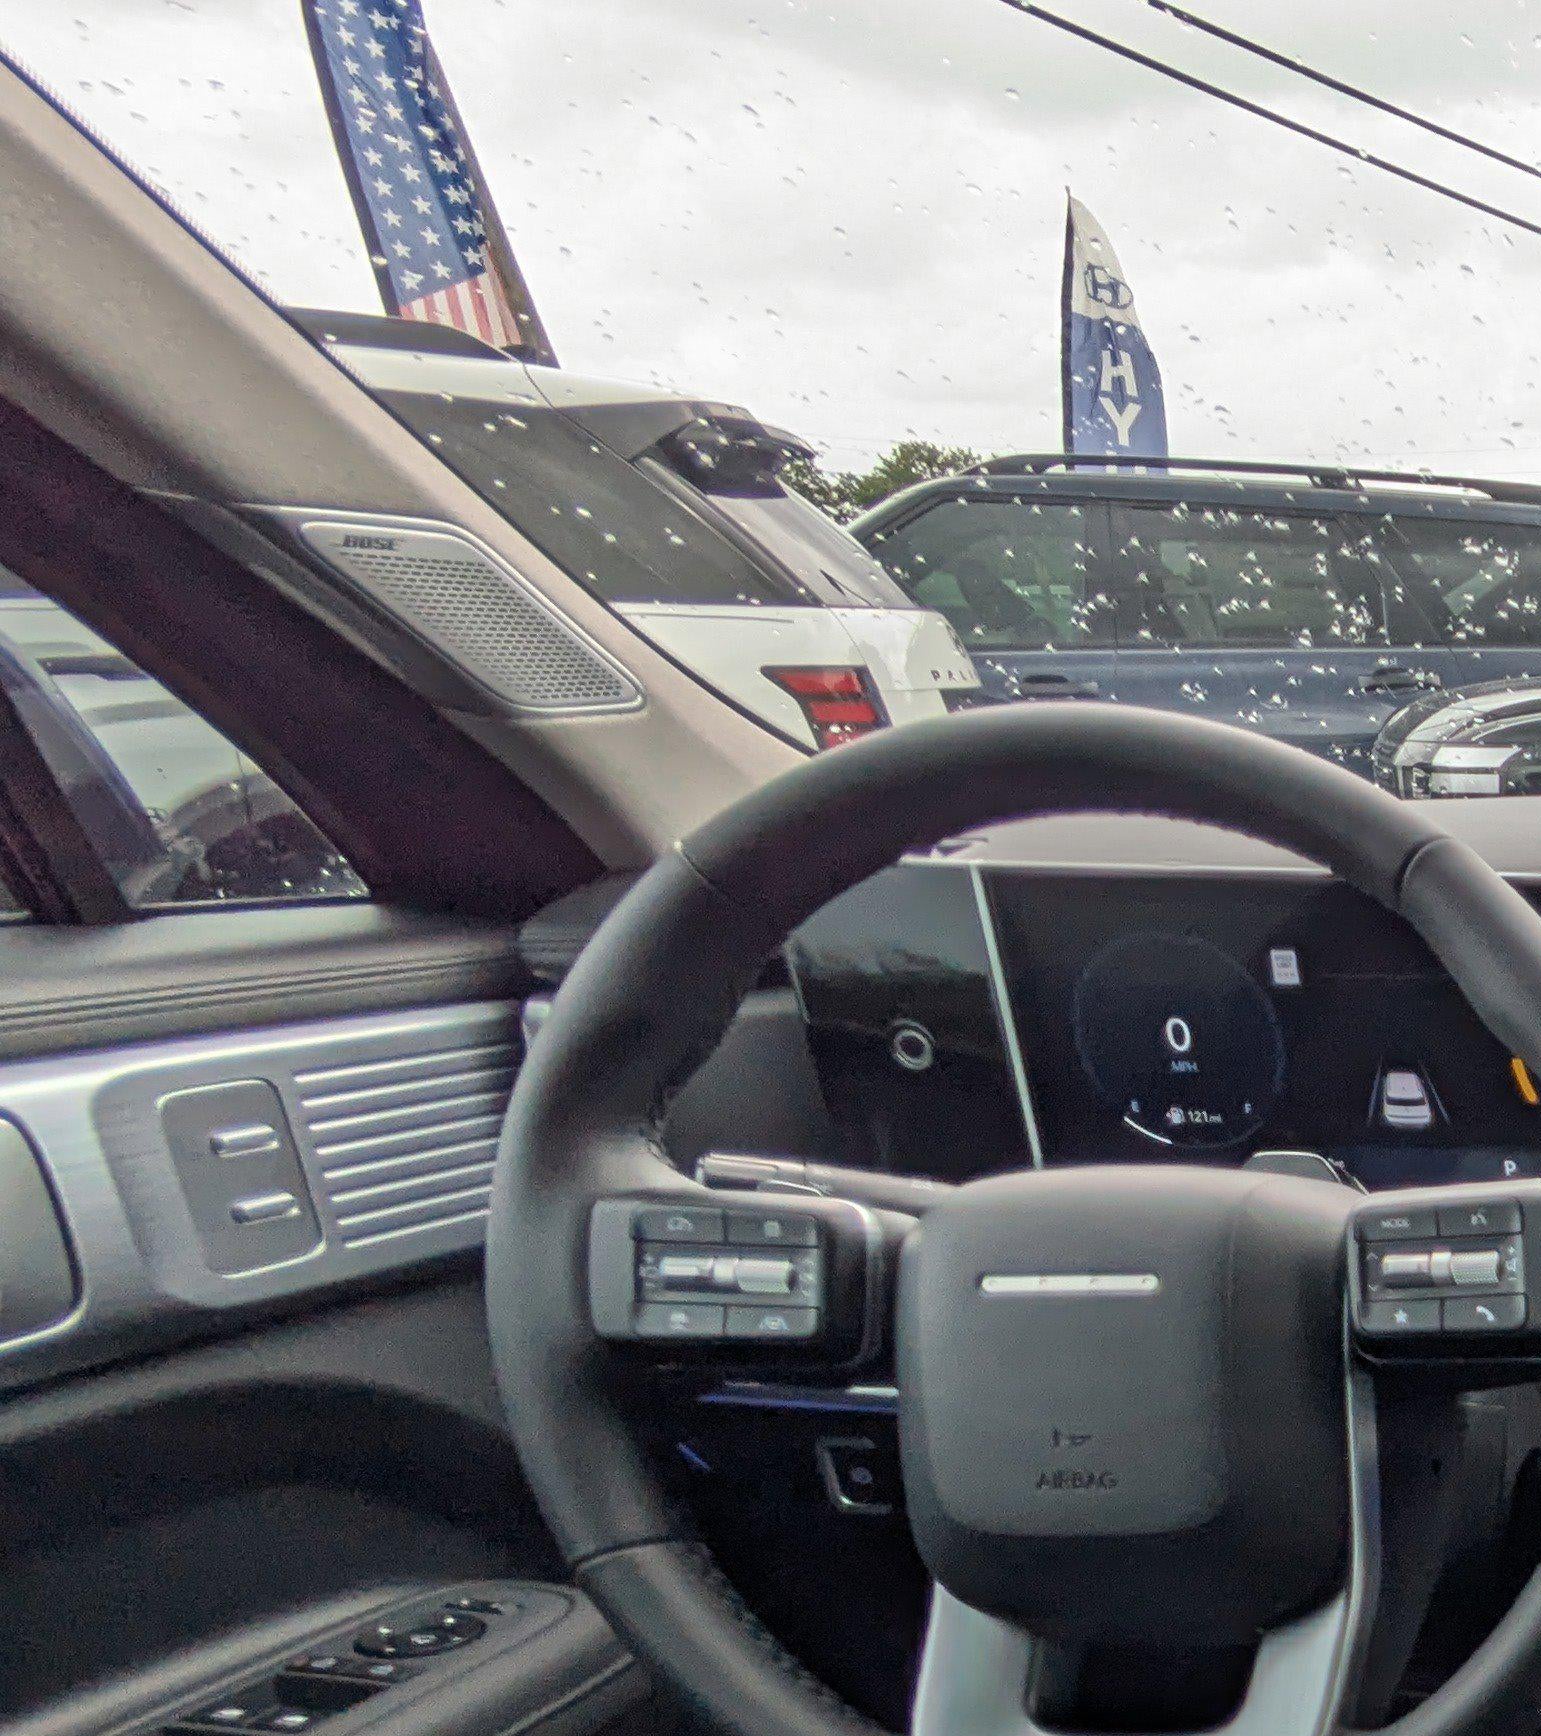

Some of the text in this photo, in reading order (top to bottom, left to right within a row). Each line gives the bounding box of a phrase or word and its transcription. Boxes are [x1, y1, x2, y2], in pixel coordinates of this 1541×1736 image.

[1165, 1017, 1191, 1051] 0
[1171, 1060, 1198, 1072] MPH
[1504, 1159, 1518, 1176] P
[1036, 1469, 1118, 1489] AIRBAG
